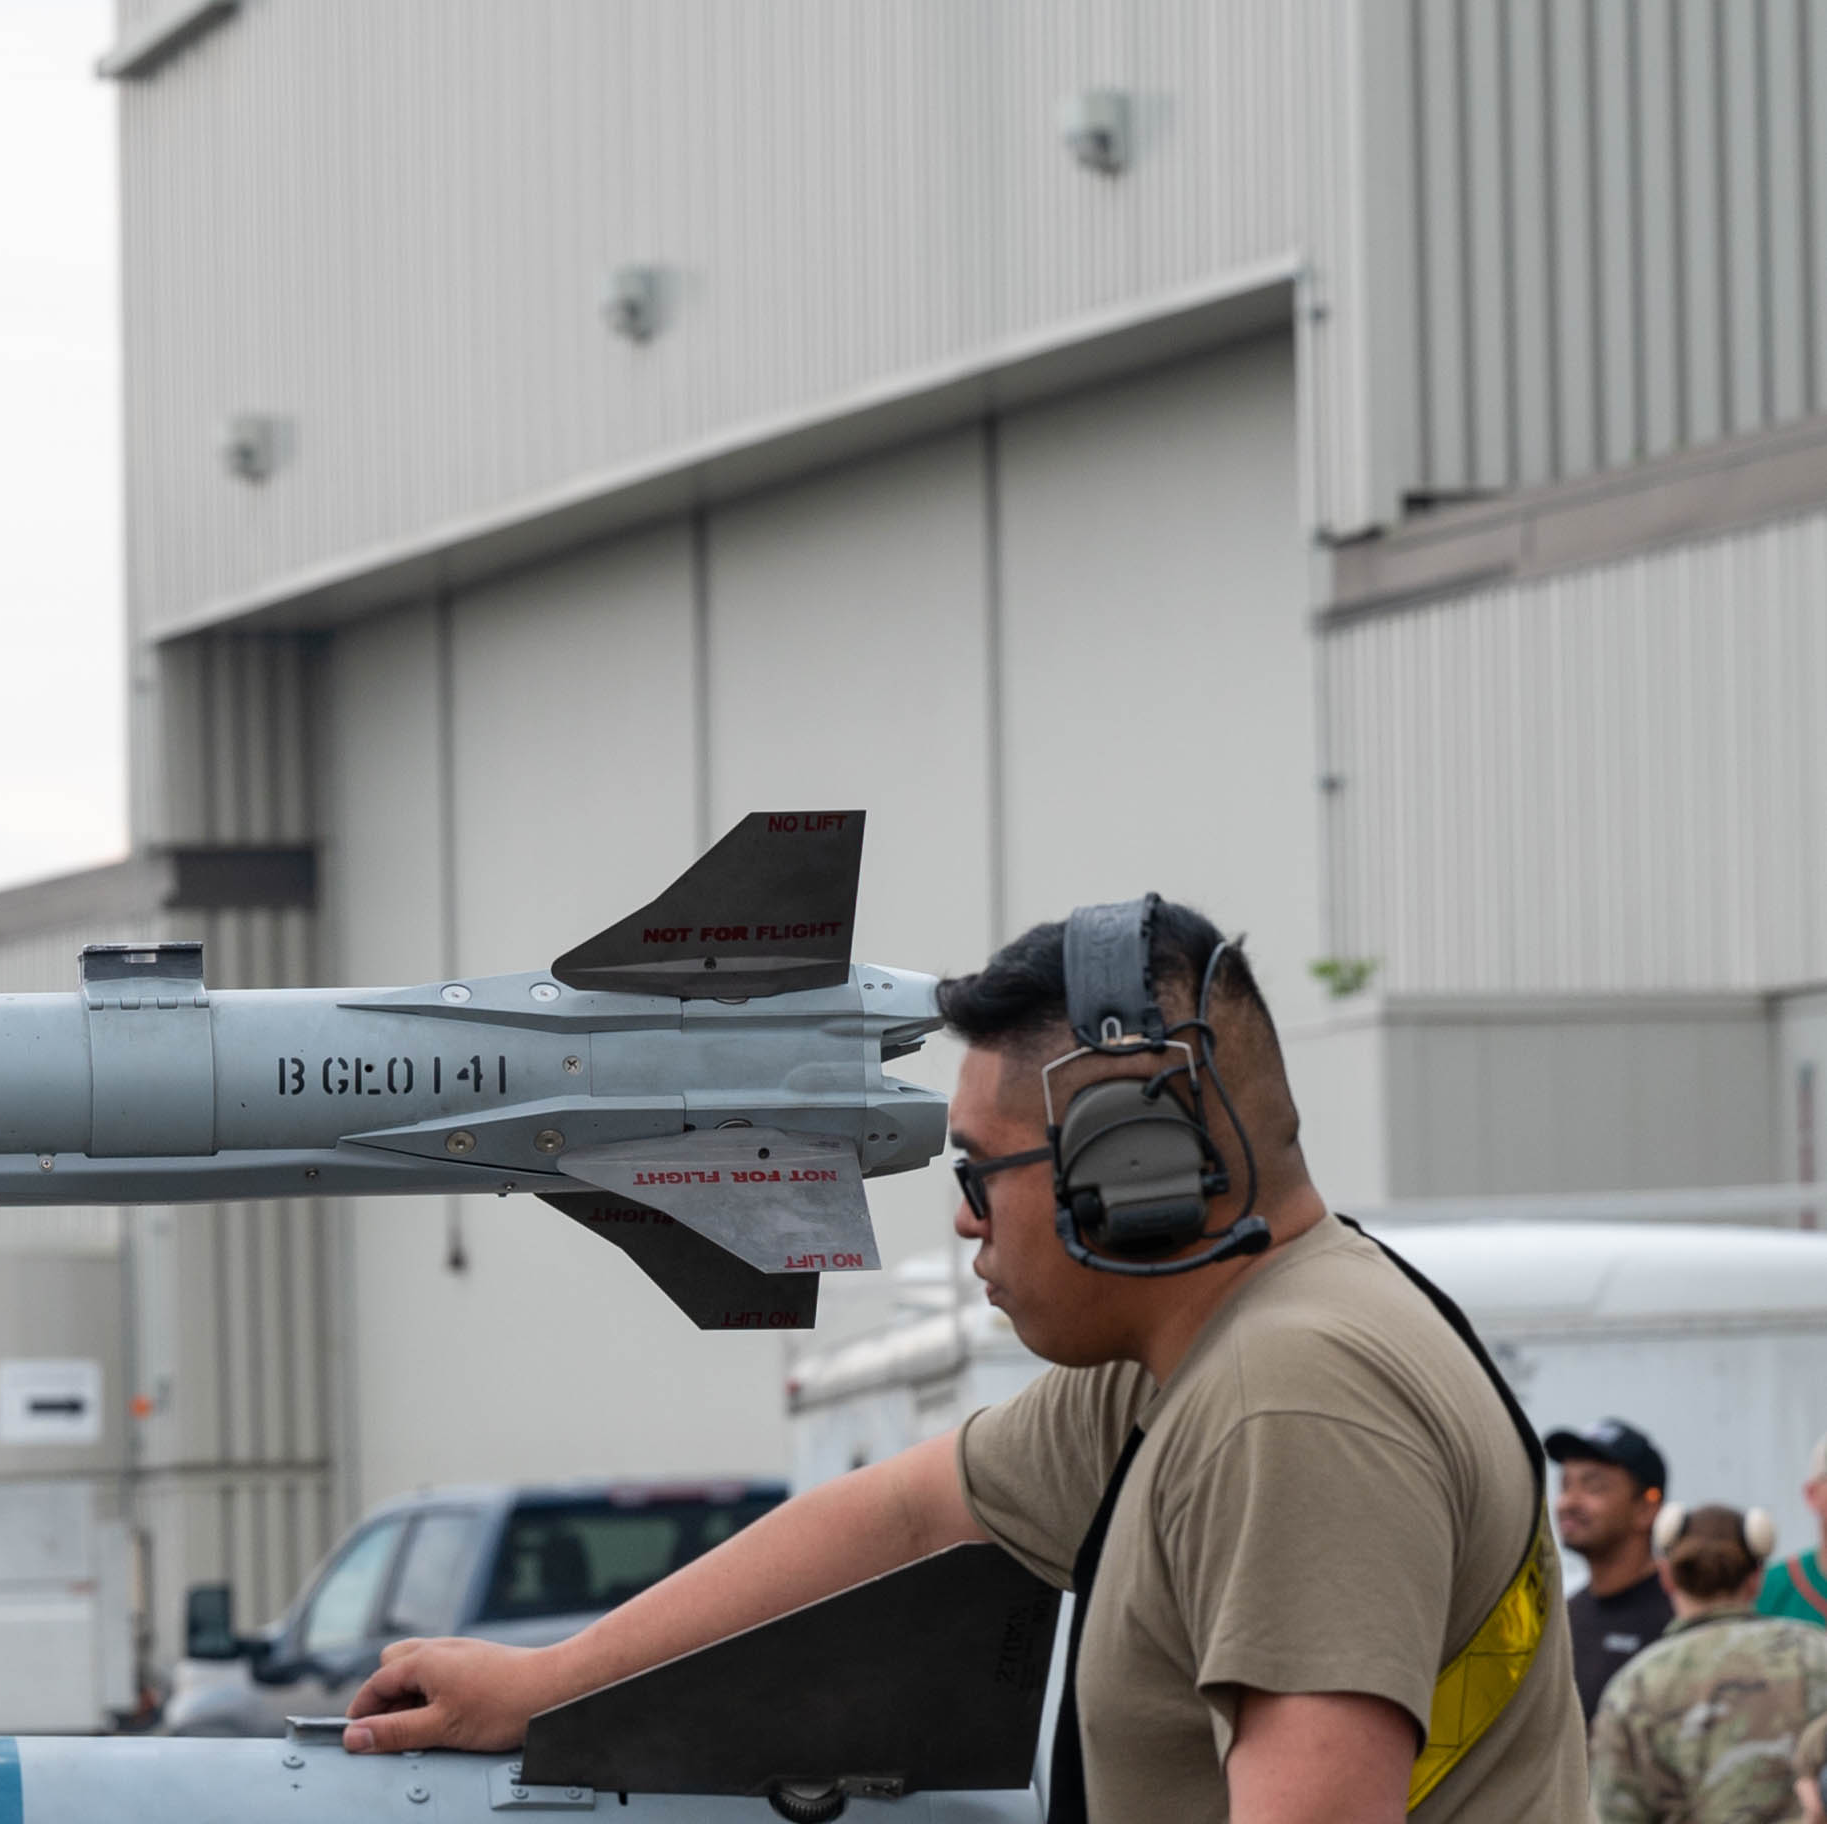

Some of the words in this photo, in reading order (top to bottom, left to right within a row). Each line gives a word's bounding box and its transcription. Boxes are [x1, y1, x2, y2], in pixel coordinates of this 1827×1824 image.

[767, 815, 799, 833] NO
[804, 814, 847, 832] LIFT
[643, 927, 694, 944] NOT
[700, 925, 750, 943] FOR
[756, 922, 843, 941] FLIGHT
[633, 1171, 721, 1185] FLIGHT
[731, 1170, 781, 1183] FOR
[789, 1170, 838, 1183] NOT
[784, 1254, 827, 1269] LIFT
[832, 1253, 863, 1268] NO
[721, 1312, 764, 1327] LIFT
[768, 1311, 800, 1326] NO
